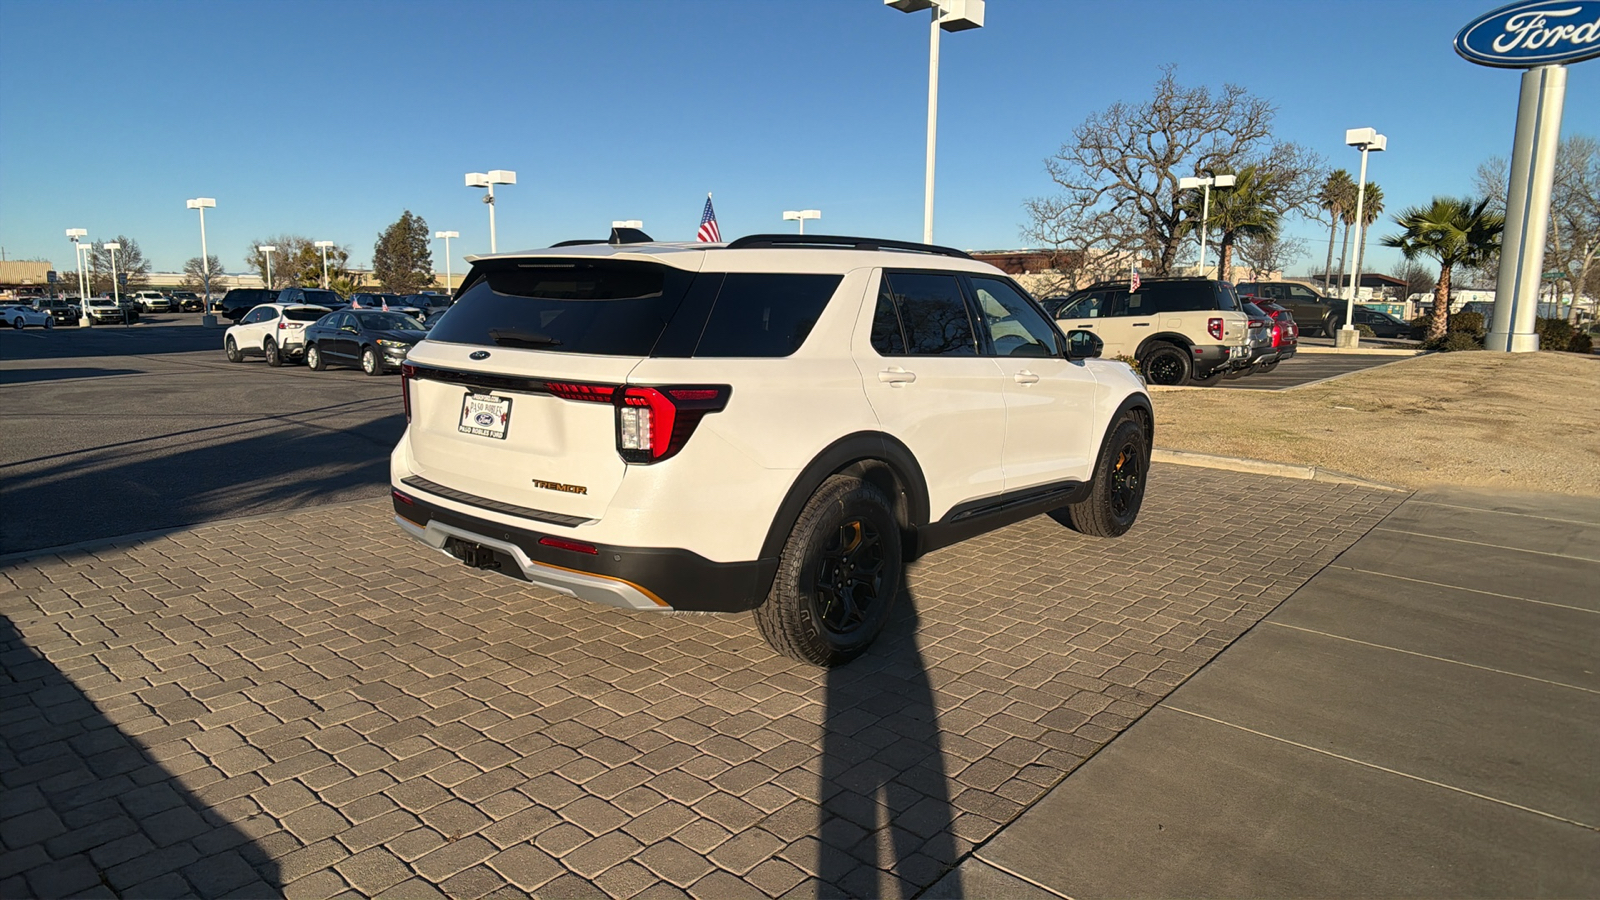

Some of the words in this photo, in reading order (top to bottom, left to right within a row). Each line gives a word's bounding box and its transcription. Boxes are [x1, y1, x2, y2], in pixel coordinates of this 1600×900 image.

[1492, 6, 1600, 53] Ford
[470, 402, 484, 413] PASO
[485, 404, 503, 417] ROBLES
[472, 428, 489, 436] ROBLES
[532, 479, 588, 495] TREMOR
